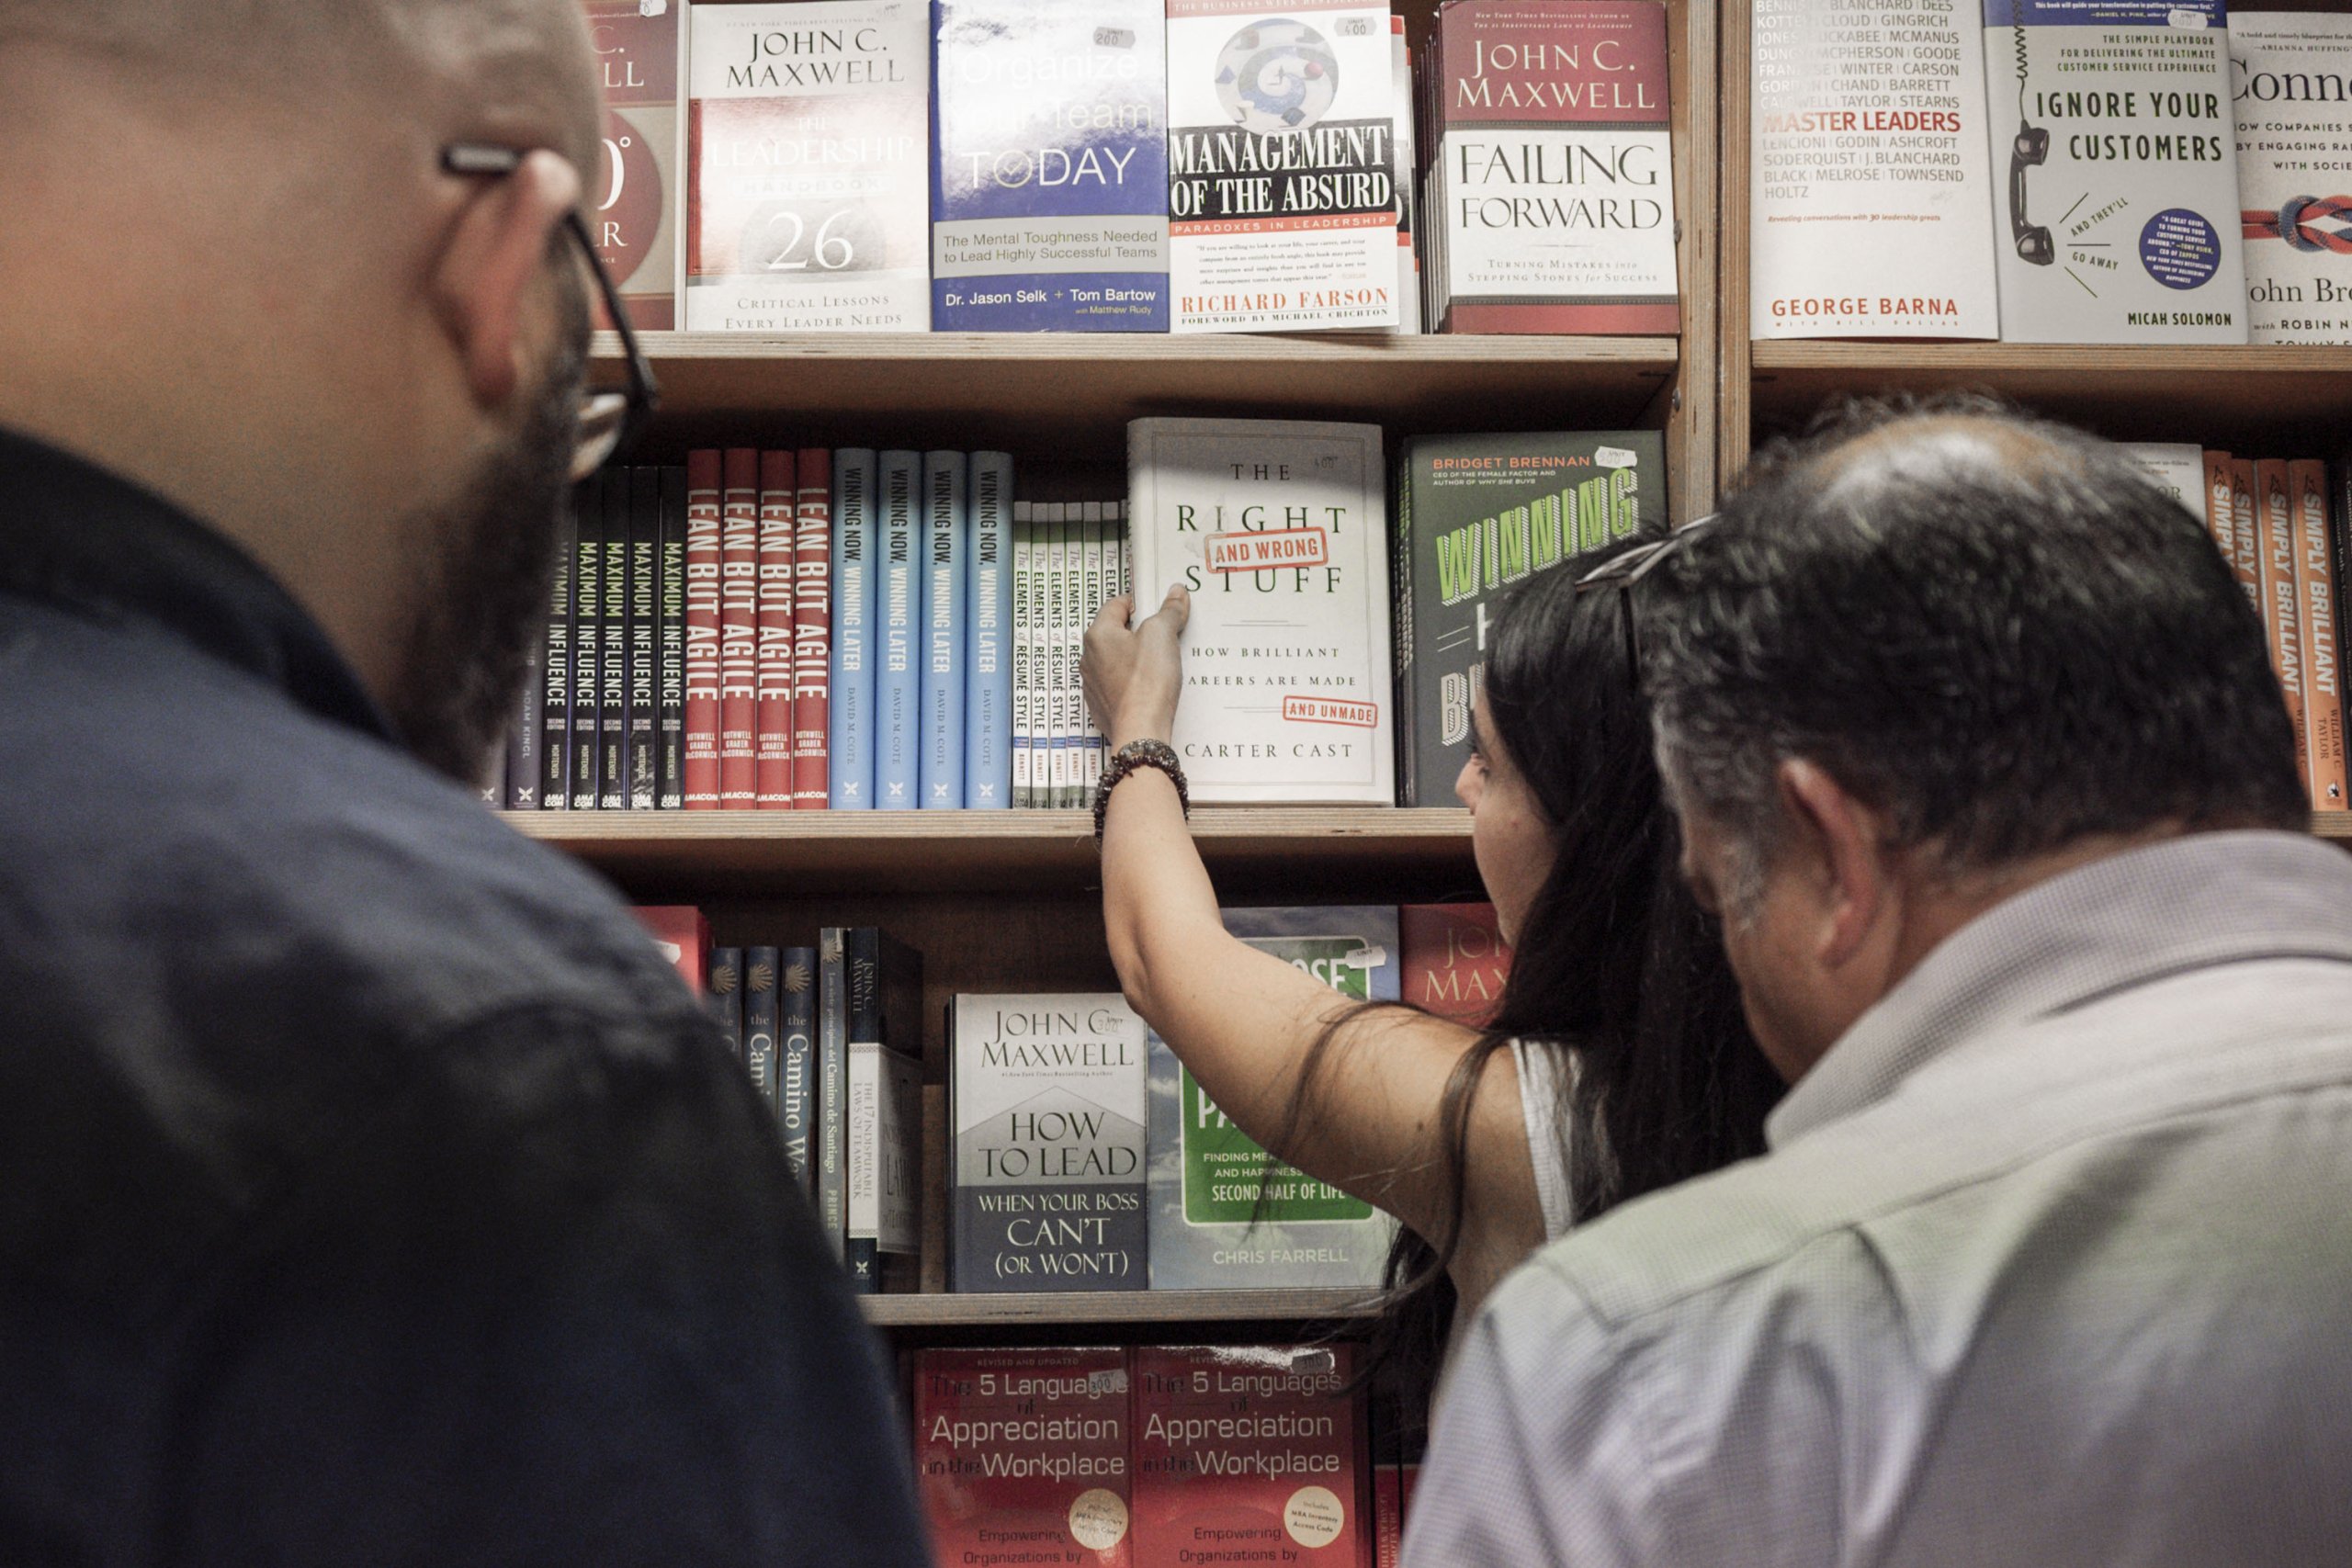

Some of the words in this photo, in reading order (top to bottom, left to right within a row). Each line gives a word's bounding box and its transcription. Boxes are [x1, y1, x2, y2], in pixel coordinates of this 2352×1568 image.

[1881, 14, 1949, 27] GINGRICH
[750, 29, 842, 62] JOHN
[854, 28, 888, 52] C.
[1889, 31, 1960, 44] MCMANUS
[2103, 35, 2121, 44] THE
[2125, 35, 2161, 44] SIMPLE
[2164, 36, 2214, 45] PLAYBOOK
[1472, 39, 1579, 79] JOHN
[1592, 40, 1635, 72] C.
[1913, 47, 1962, 61] GOODE
[2061, 49, 2079, 58] FOR
[2084, 49, 2143, 58] DELIVERING
[2147, 49, 2165, 58] THE
[2169, 50, 2216, 59] ULTIMATE
[727, 59, 905, 88] MAXWELL
[1840, 63, 1894, 75] WINTER
[1903, 63, 1960, 76] CARSON
[2058, 62, 2109, 72] CUSTOMER
[2113, 62, 2154, 72] SERVICE
[2158, 63, 2217, 73] EXPERIENCE
[1457, 78, 1656, 108] MAXWELL
[1831, 79, 1880, 91] CHAND
[1889, 79, 1951, 92] BARRETT
[1841, 96, 1892, 107] TAYLOR
[1899, 96, 1960, 108] STEARNS
[2037, 93, 2137, 118] IGNORE
[2151, 93, 2219, 118] YOUR
[1762, 112, 1857, 133] MASTER
[1863, 111, 1962, 132] LEADERS
[2266, 122, 2343, 132] COMPANIES
[1170, 125, 1388, 175] MANAGEMENT
[1835, 136, 1881, 149] GODIN
[1889, 137, 1958, 150] ASHCROFT
[2070, 135, 2222, 161] CUSTOMERS
[2236, 142, 2253, 152] BY
[2258, 142, 2326, 152] ENGAGING
[961, 147, 1136, 188] TODAY
[1460, 144, 1657, 186] FAILING
[1764, 170, 1807, 183] BLACK
[1815, 169, 1881, 182] MELROSE
[1889, 168, 1963, 182] TOWNSEND
[2273, 162, 2308, 171] WITH
[1170, 179, 1209, 217] OF
[1216, 177, 1272, 215] THE
[1282, 172, 1391, 212] ABSURD
[1765, 186, 1809, 198] HOLTZ
[1174, 222, 1261, 233] PARADOXES
[1270, 221, 1284, 230] IN
[1294, 217, 1387, 229] LEADERSHIP
[1462, 197, 1662, 229] FORWARD
[2071, 221, 2089, 237] AND
[2091, 197, 2129, 225] THEY'LL
[766, 209, 854, 270] 26
[944, 235, 968, 248] The
[973, 232, 1020, 246] Mental
[1024, 231, 1099, 248] Toughness
[1103, 231, 1158, 243] Needed
[944, 252, 956, 264] to
[961, 250, 992, 262] Lead
[996, 247, 1036, 263] Highly
[1040, 246, 1111, 259] Successful
[1115, 246, 1158, 258] Teams
[1487, 259, 1544, 269] TURNING
[1550, 259, 1611, 269] MISTAKES
[2072, 252, 2086, 263] GO
[2089, 256, 2119, 270] AWAY
[1468, 273, 1529, 282] STEPPING
[1534, 273, 1580, 282] STONES
[1604, 273, 1658, 282] SUCCESS
[738, 297, 817, 310] CRITICAL
[822, 295, 890, 307] LESSONS
[945, 293, 965, 307] Dr.
[969, 291, 1012, 305] Jason
[1016, 290, 1046, 304] Selk
[1069, 288, 1101, 302] Tom
[1105, 288, 1156, 302] Bartow
[1182, 292, 1287, 313] RICHARD
[1300, 288, 1388, 307] FARSON
[1772, 299, 1869, 317] GEORGE
[1880, 298, 1958, 315] BARNA
[725, 318, 776, 331] EVERY
[783, 315, 844, 329] LEADER
[851, 314, 903, 326] NEEDS
[1182, 315, 1246, 324] FOREWORD
[1251, 314, 1266, 322] BY
[1272, 311, 1323, 321] MICHAEL
[1329, 309, 1388, 319] CRICHTON
[2128, 312, 2168, 325] MICAH
[2172, 312, 2232, 326] SOLOMON
[2281, 320, 2332, 330] ROBIN
[1231, 464, 1290, 480] THE
[1433, 458, 1503, 469] BRIDGET
[1510, 457, 1590, 468] BRENNAN
[844, 468, 862, 526] WINNING
[687, 489, 718, 550] LEAN
[797, 488, 828, 550] LEAN
[1177, 505, 1347, 534] RIGHT
[843, 530, 861, 563] NOW,
[1436, 468, 1639, 606] WINNING
[2303, 494, 2328, 577] SIMPLY
[1216, 544, 1250, 562] AND
[1255, 537, 1318, 559] WRONG
[578, 542, 597, 616] MAXIMUM
[664, 542, 682, 616] MAXIMUM
[687, 563, 718, 615] BUT
[796, 562, 828, 614] BUT
[1185, 566, 1341, 592] STUFF
[844, 567, 861, 626] WINNING
[1016, 570, 1028, 628] ELEMENTS
[843, 630, 861, 671] LATER
[2309, 581, 2335, 696] BRILLIANT
[577, 625, 595, 706] INFLUENCE
[662, 625, 681, 706] INFLUENCE
[686, 626, 718, 701] AGILE
[795, 625, 827, 700] AGILE
[1192, 648, 1229, 657] HOW
[1242, 648, 1340, 658] BRILLIANT
[1188, 676, 1255, 686] AREERS
[1265, 676, 1298, 686] ARE
[1309, 676, 1357, 686] MADE
[1016, 694, 1027, 728] STYLE
[1290, 703, 1315, 716] AND
[1320, 705, 1372, 722] UNMADE
[1185, 743, 1277, 758] CARTER
[1293, 743, 1353, 758] CAST
[994, 1010, 1078, 1043] JOHN
[981, 1042, 1134, 1067] MAXWELL
[786, 1034, 809, 1129] Camino
[1012, 1111, 1104, 1141] HOW
[978, 1148, 1029, 1177] TO
[1040, 1147, 1136, 1176] LEAD
[979, 1195, 1034, 1212] WHEN
[1040, 1194, 1090, 1211] YOUR
[1096, 1193, 1138, 1211] BOSS
[1212, 1185, 1260, 1201] SECOND
[1007, 1217, 1110, 1247] CAN'T
[995, 1251, 1032, 1279] (OR
[1040, 1250, 1128, 1277] WON'T)
[1213, 1250, 1265, 1265] CHRIS
[1272, 1248, 1348, 1263] FARRELL
[1193, 1371, 1208, 1393] 5
[1218, 1371, 1342, 1396] Languages
[931, 1414, 1118, 1449] Appreciation
[1145, 1411, 1332, 1447] Appreciation
[981, 1452, 1125, 1483] Workplace
[1194, 1450, 1340, 1481] Workplace
[1194, 1528, 1282, 1540] Empowering
[1180, 1549, 1276, 1562] Organizations
[1283, 1549, 1297, 1562] by
